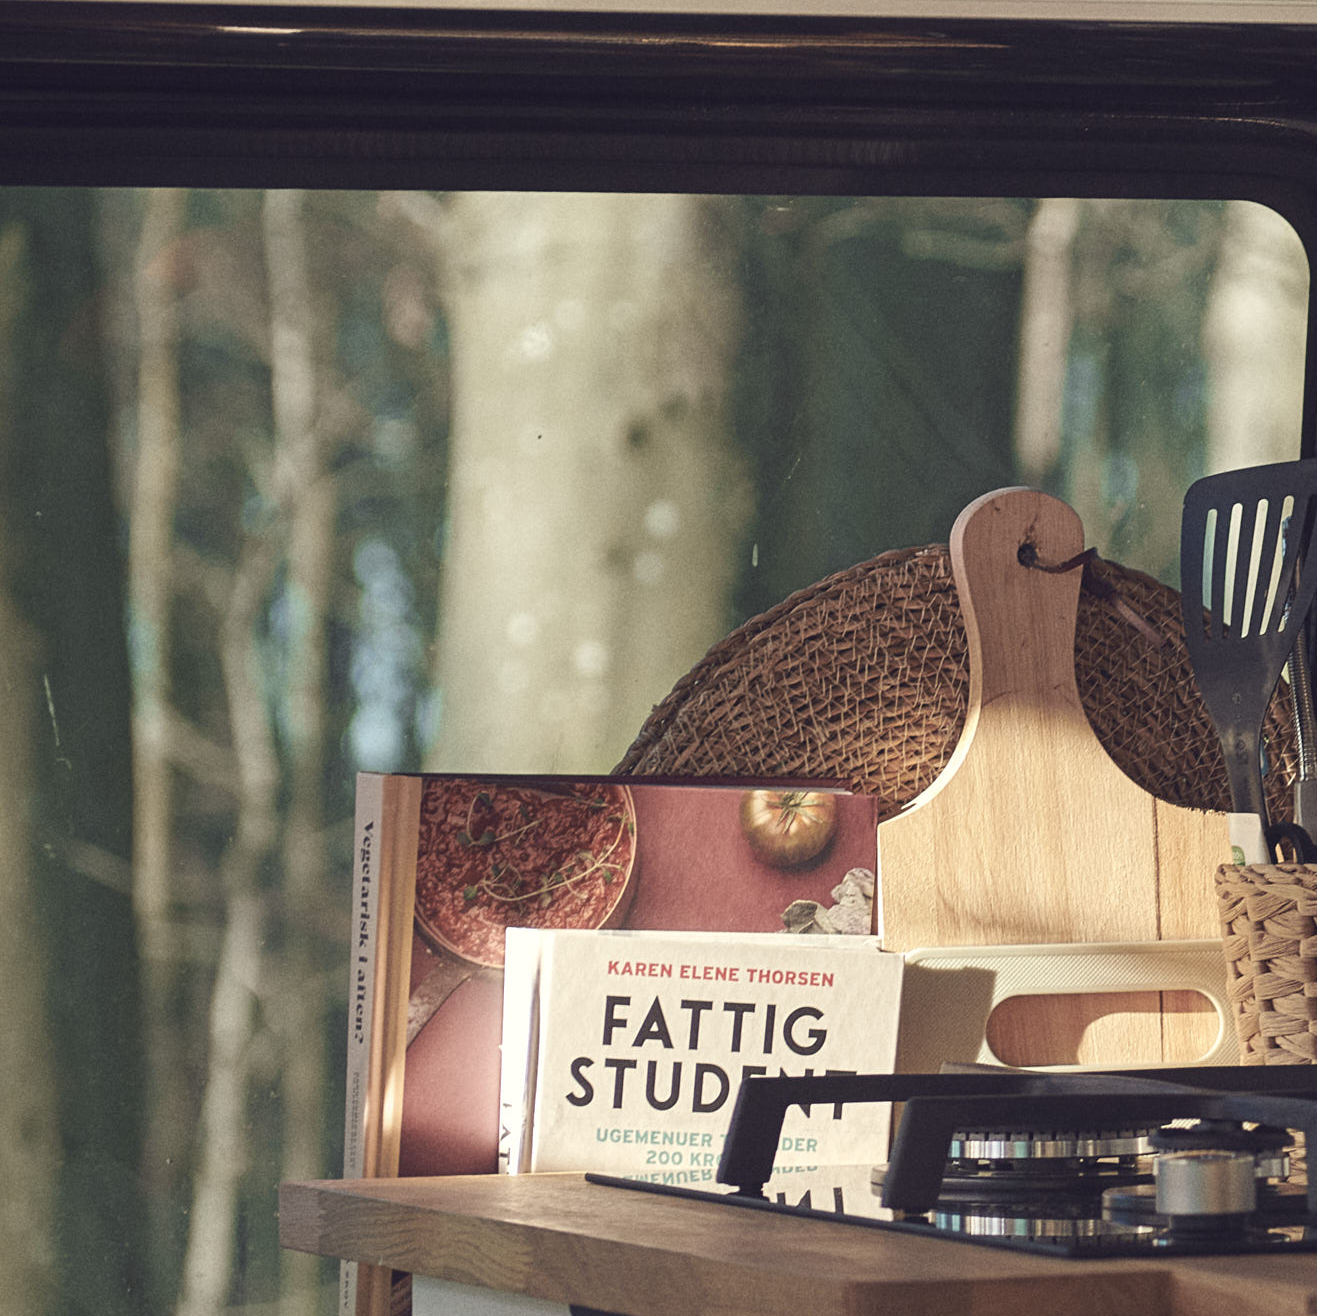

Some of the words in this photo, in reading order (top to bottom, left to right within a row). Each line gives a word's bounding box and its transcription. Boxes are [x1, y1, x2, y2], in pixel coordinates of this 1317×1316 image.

[358, 820, 375, 949] Vegetarisk
[358, 955, 368, 964] i
[607, 960, 673, 979] KAREN
[679, 964, 740, 982] ELENE
[747, 968, 834, 987] THORSEN
[354, 968, 369, 1045] aften?
[602, 994, 828, 1057] FATTIG
[565, 1056, 858, 1121] STUD
[596, 1127, 713, 1148] UGEMENUER
[645, 1149, 684, 1166] 200
